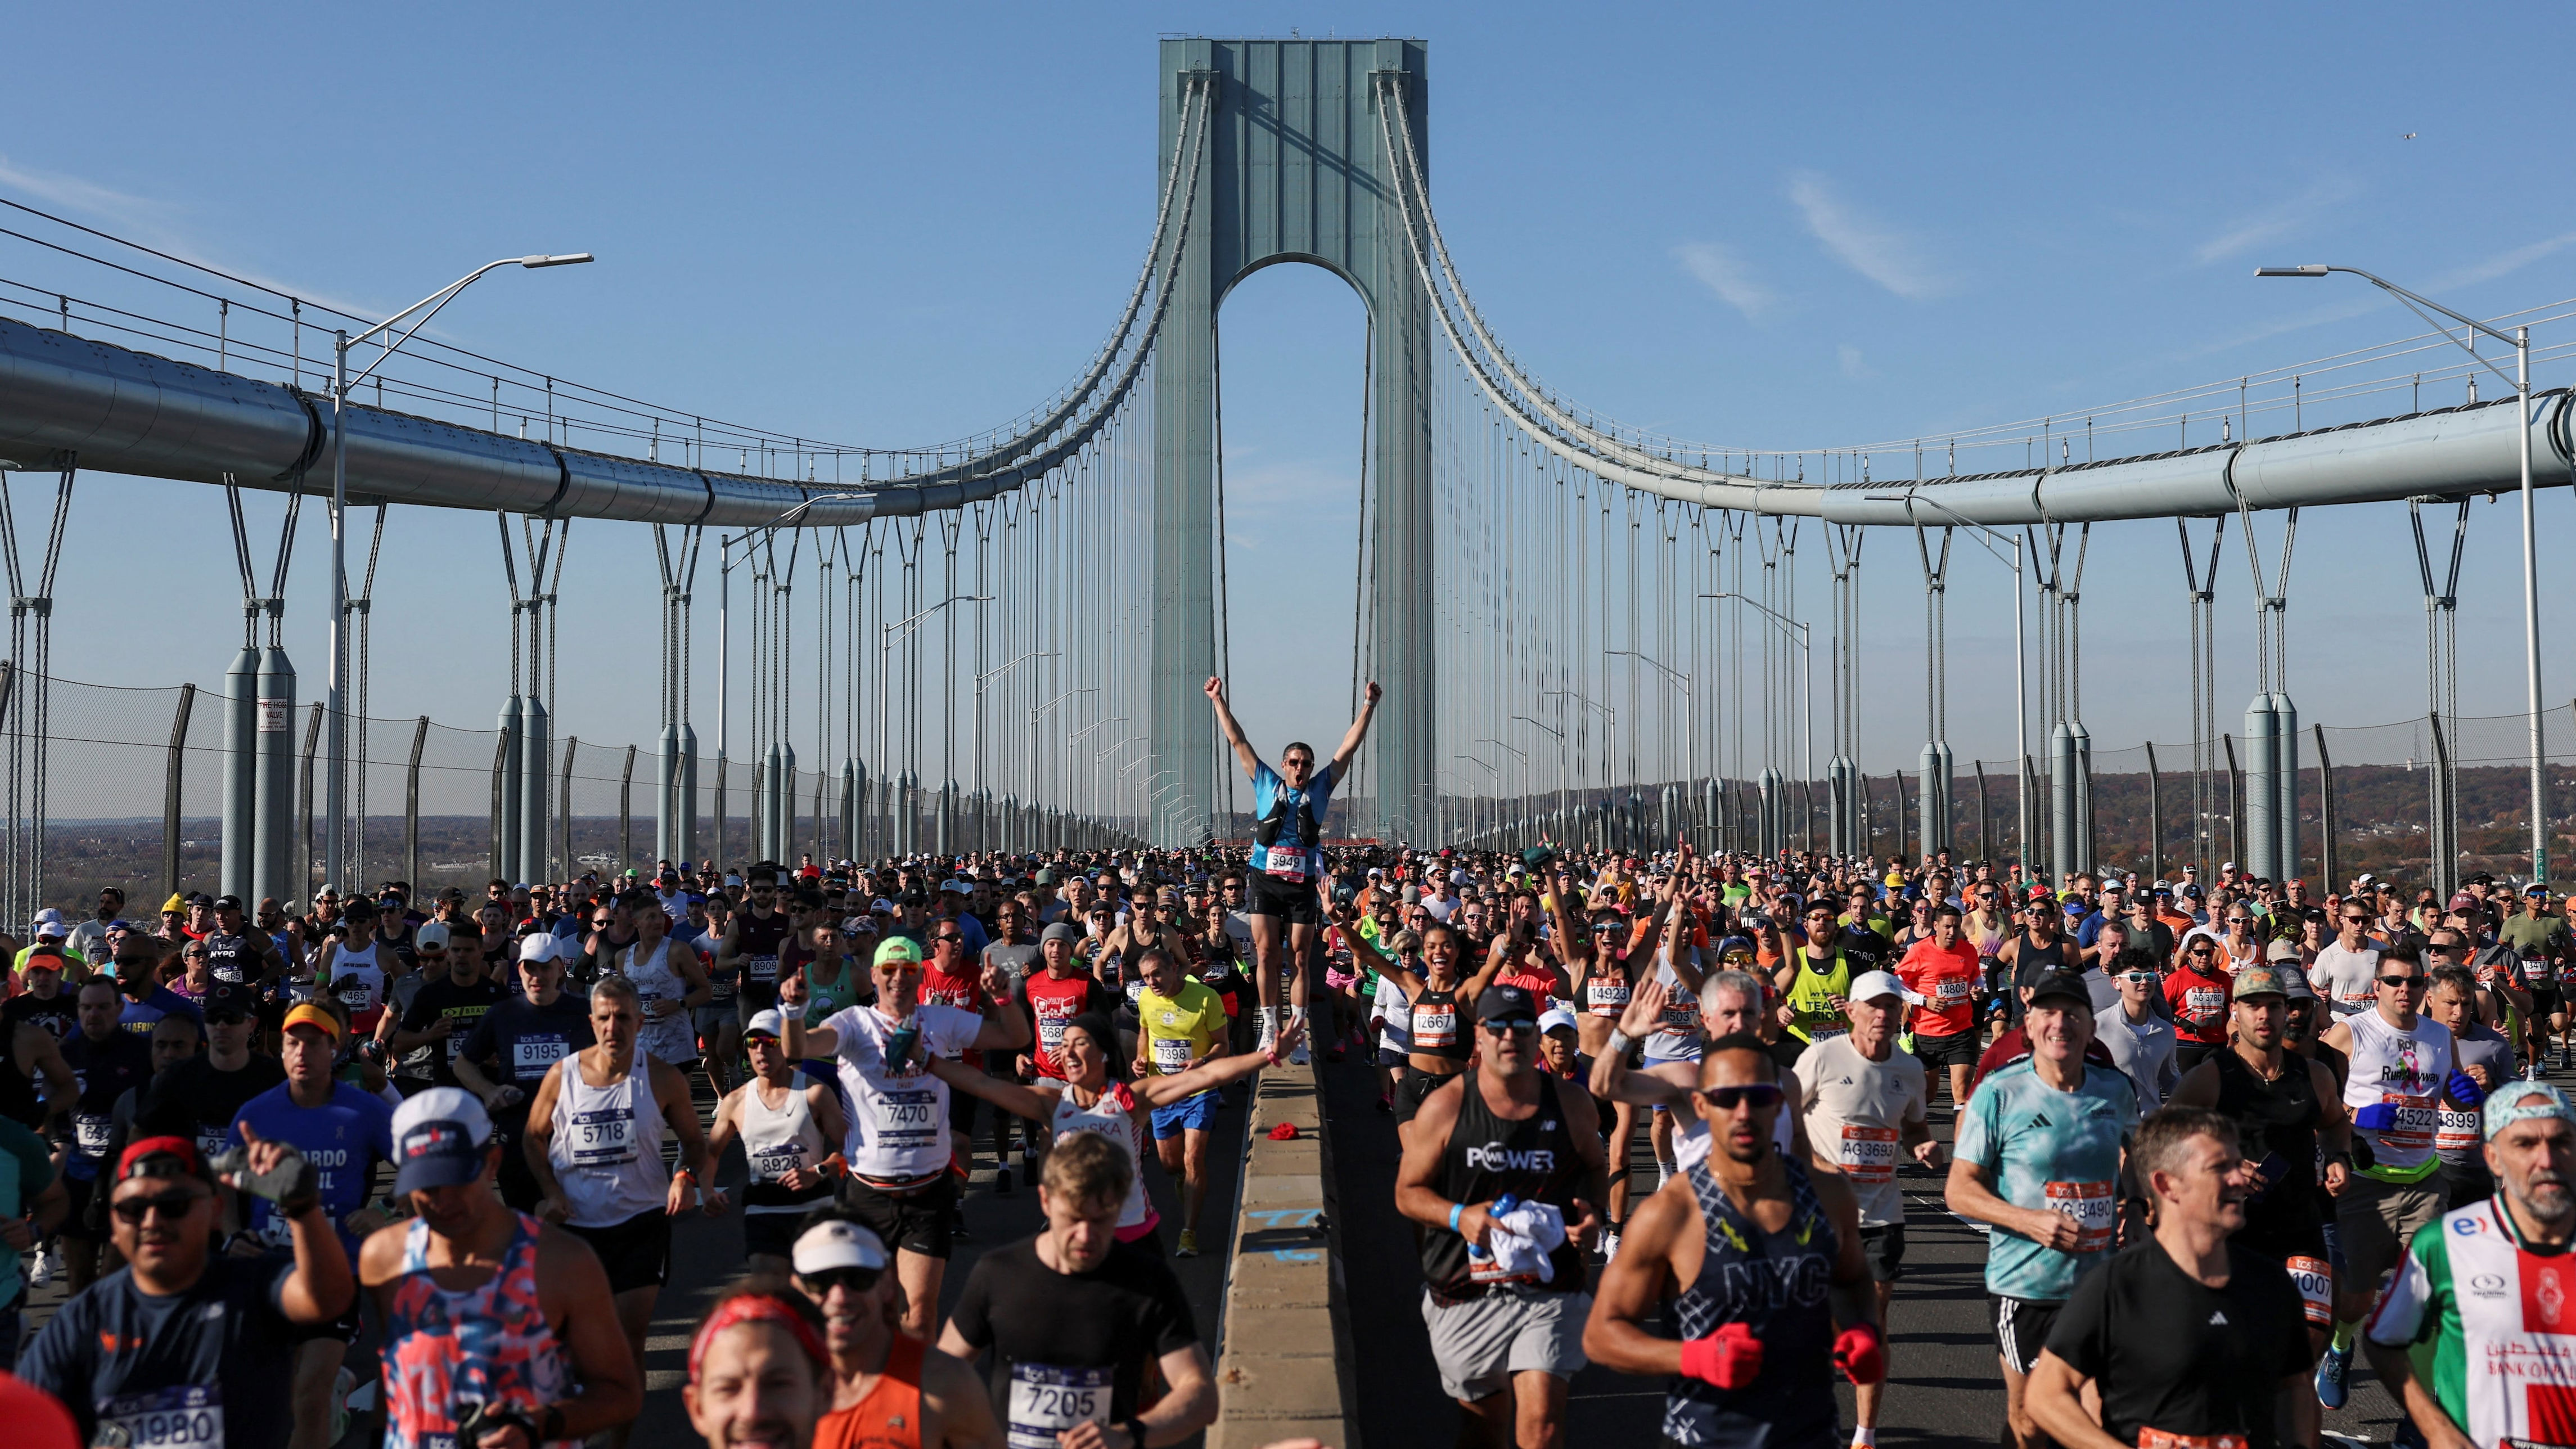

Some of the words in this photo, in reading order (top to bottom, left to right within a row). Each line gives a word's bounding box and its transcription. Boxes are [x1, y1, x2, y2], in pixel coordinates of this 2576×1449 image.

[1273, 854, 1300, 867] 5949
[754, 961, 777, 970] 8909
[344, 991, 365, 1000] 7465
[1592, 988, 1627, 1000] 14923
[1939, 983, 1966, 995] 14808
[2350, 1001, 2372, 1010] 9877
[1418, 1015, 1451, 1028] 12667
[1665, 1011, 1695, 1022] 15037
[2397, 1038, 2417, 1052] ROY
[524, 1045, 559, 1059] 9195
[1160, 1048, 1186, 1059] 7398
[888, 1105, 928, 1123] 7470
[584, 1123, 624, 1143] 5718
[1849, 1129, 1863, 1138] tcs
[1843, 1142, 1862, 1155] AG
[1865, 1143, 1893, 1157] 3693
[762, 1155, 801, 1173] 8928
[2051, 1203, 2073, 1216] AG
[2079, 1202, 2111, 1218] 3490
[2296, 1259, 2312, 1270] tcs
[1723, 1253, 1830, 1311] NYC
[2488, 1361, 2525, 1376] BANK
[1029, 1386, 1095, 1417] 7205
